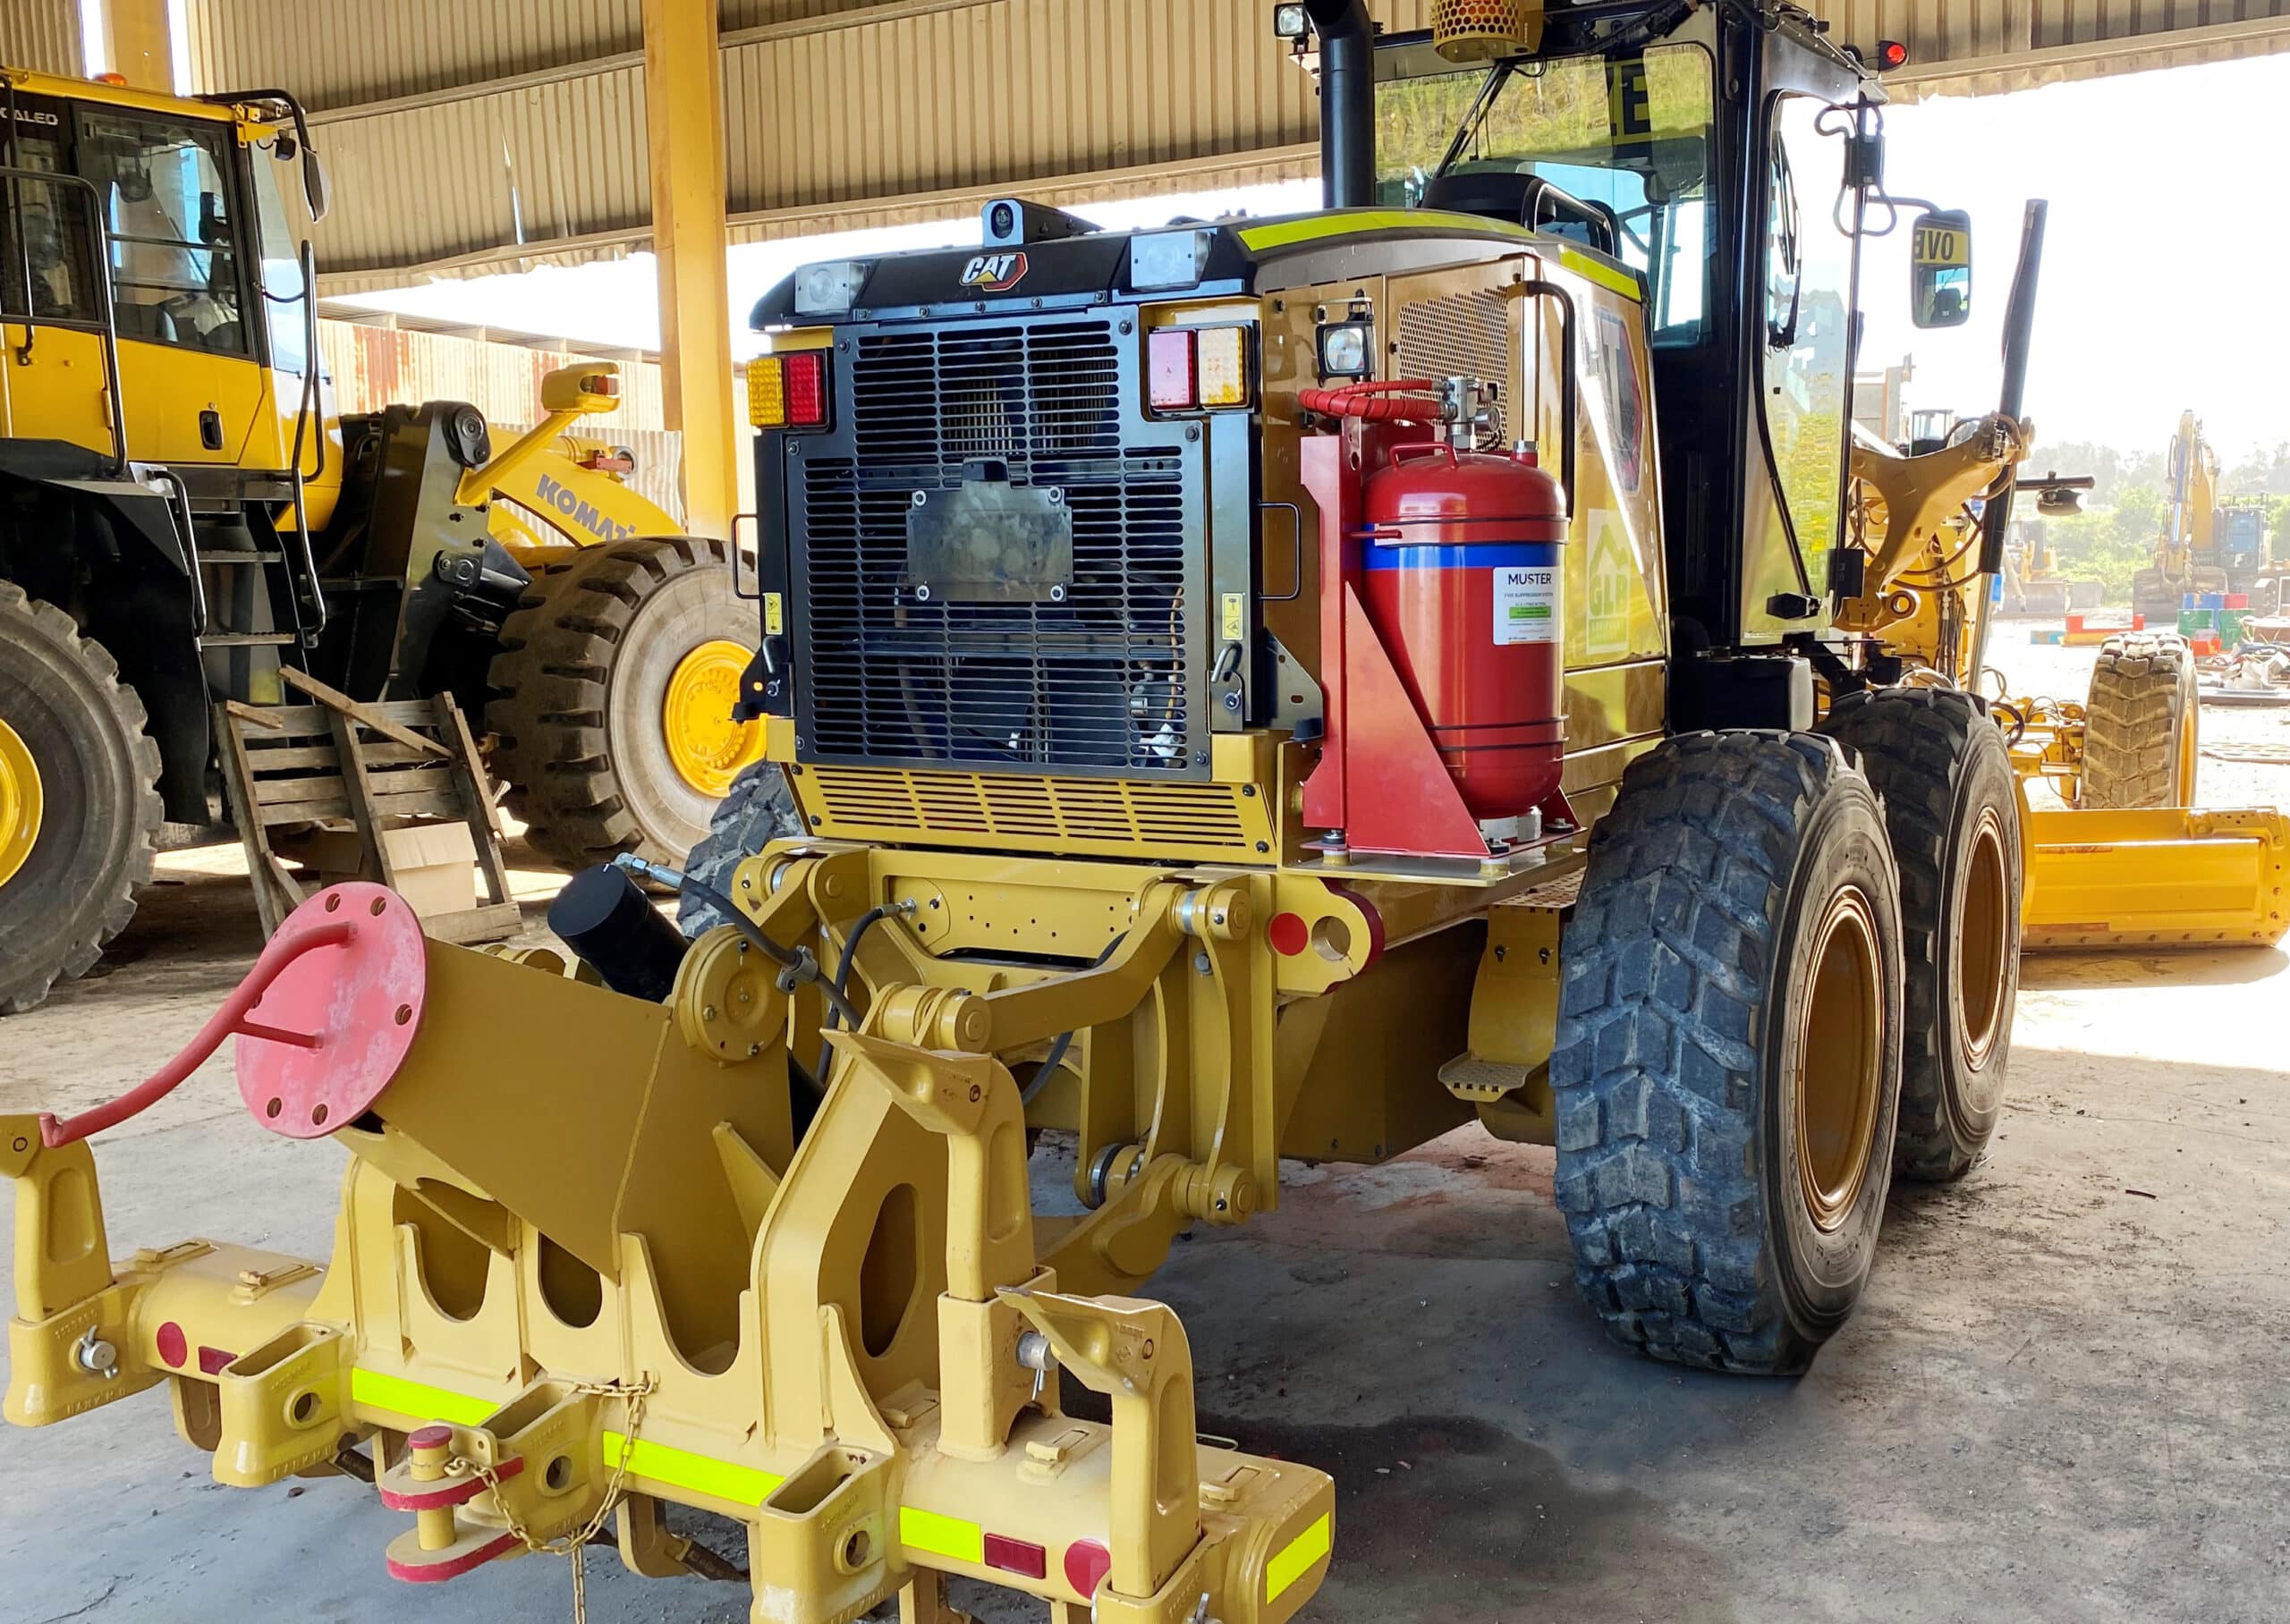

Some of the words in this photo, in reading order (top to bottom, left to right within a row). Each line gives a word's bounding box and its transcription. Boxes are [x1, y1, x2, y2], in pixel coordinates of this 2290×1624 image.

[963, 255, 1017, 283] CAT
[537, 473, 636, 542] KOMAT
[1508, 573, 1551, 585] MUSTER
